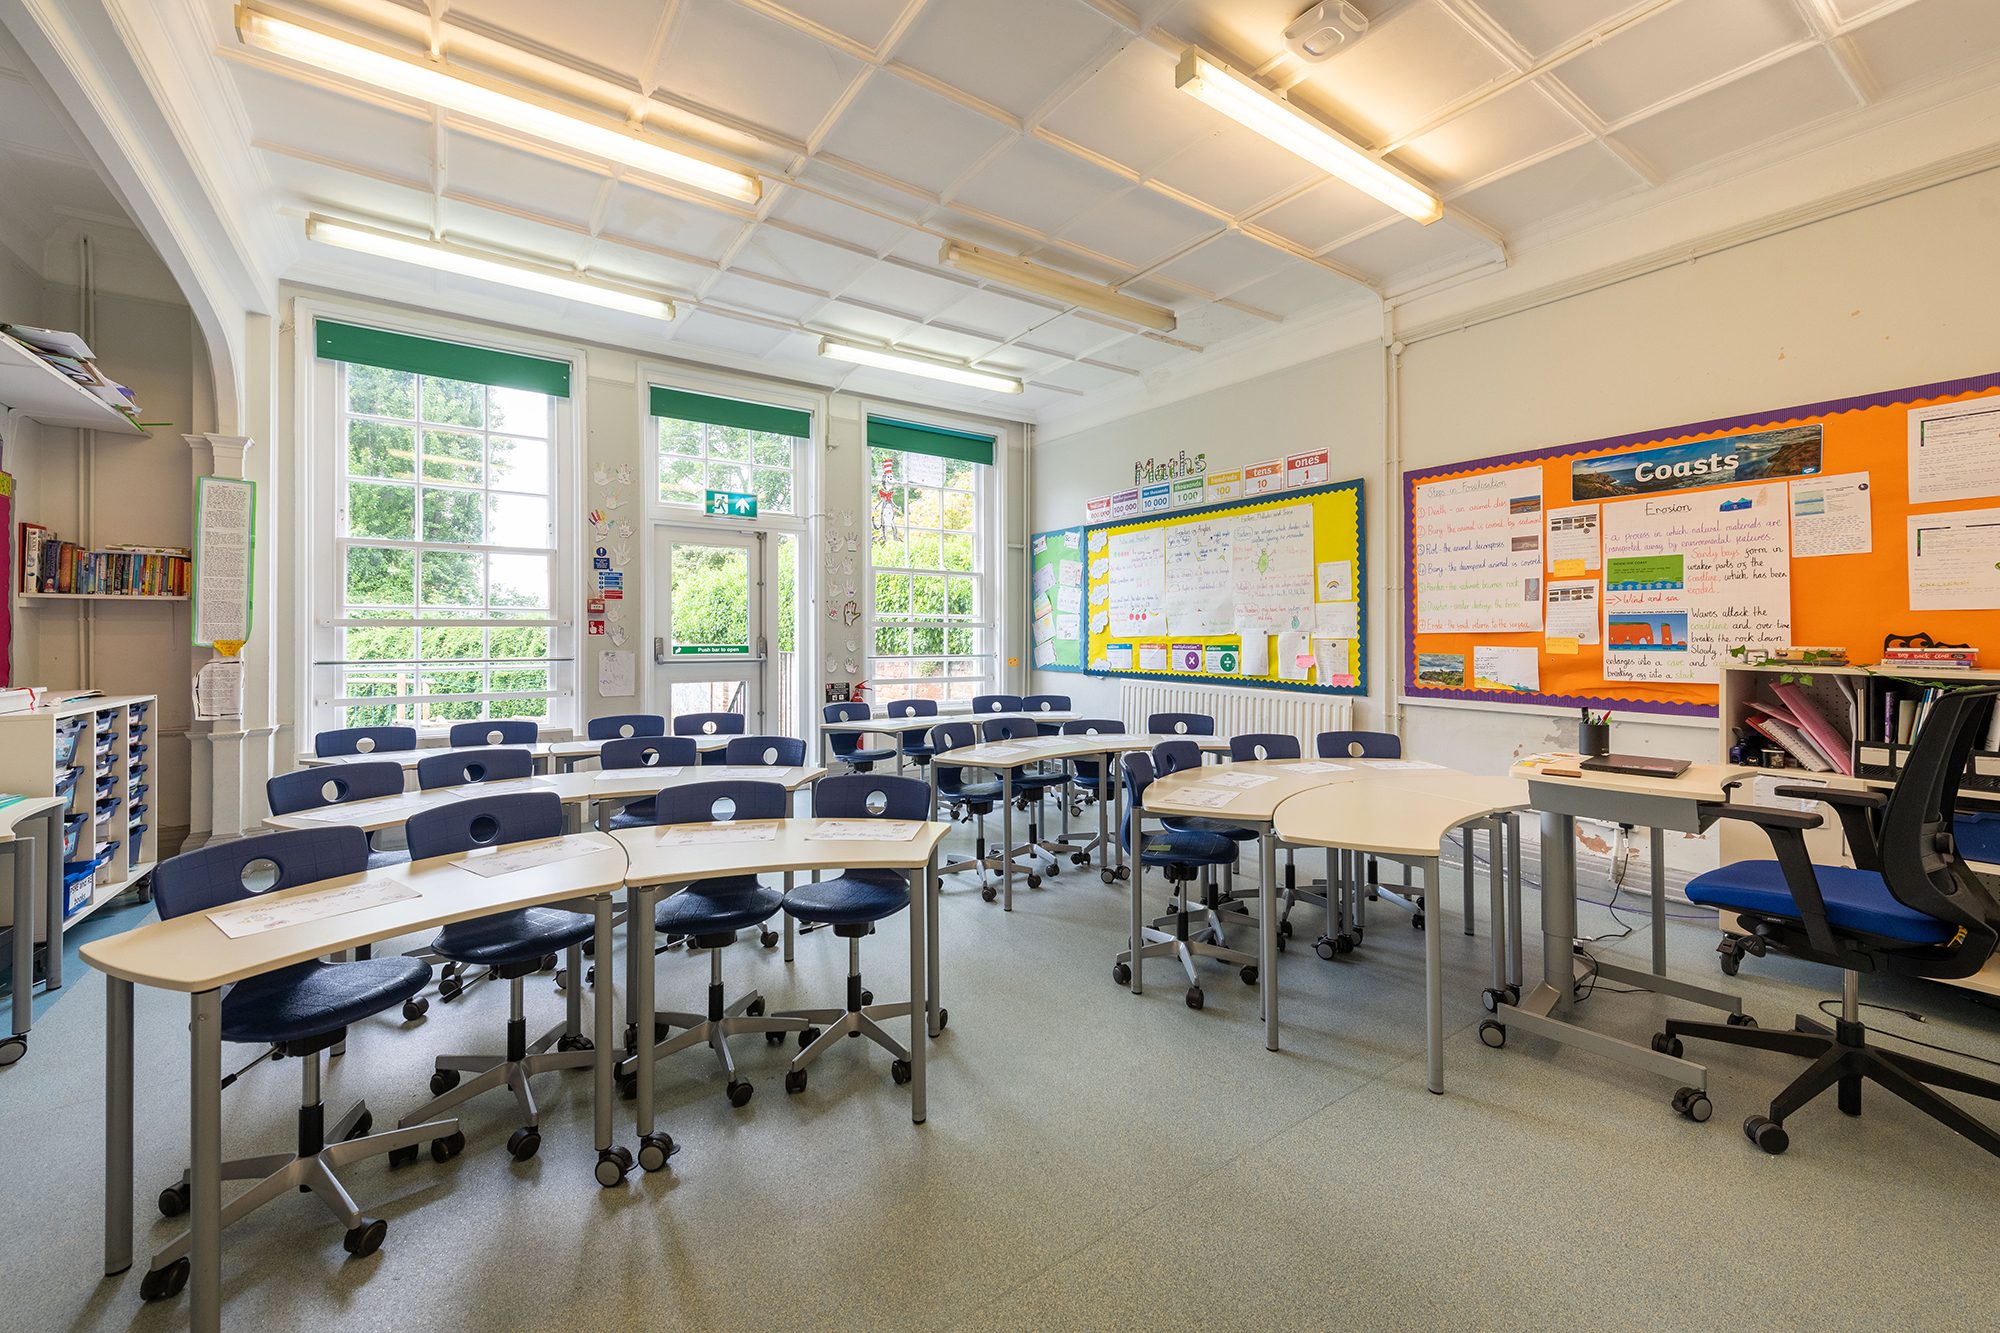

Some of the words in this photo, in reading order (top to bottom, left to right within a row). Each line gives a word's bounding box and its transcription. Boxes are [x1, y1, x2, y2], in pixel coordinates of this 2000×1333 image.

[1135, 450, 1207, 486] Maths
[1295, 456, 1320, 468] ones
[1634, 453, 1740, 482] Coasts
[1254, 467, 1272, 476] tens
[1304, 470, 1309, 480] 1
[1216, 486, 1230, 495] 100
[1258, 479, 1268, 488] 10
[1646, 502, 1692, 516] Erosion
[1625, 532, 1650, 543] process
[1666, 525, 1687, 536] which
[1692, 520, 1720, 534] natural
[1726, 518, 1761, 531] materials
[1644, 544, 1664, 554] away
[1668, 540, 1678, 552] by
[1692, 547, 1718, 562] Sandy
[1720, 546, 1740, 558] bays
[1744, 547, 1768, 558] form
[1688, 560, 1712, 570] weaker
[1716, 559, 1734, 572] parts
[1737, 562, 1748, 570] of
[1751, 557, 1764, 567] the
[1724, 570, 1748, 582] which
[1752, 569, 1767, 579] has
[1770, 568, 1788, 578] been
[1623, 592, 1644, 604] Wind
[1648, 591, 1662, 602] and
[1691, 607, 1718, 618] Waves
[1722, 606, 1749, 618] attack
[1753, 606, 1768, 616] the
[1732, 619, 1752, 630] and
[1691, 632, 1714, 642] breaks
[1718, 633, 1731, 642] the
[1734, 632, 1754, 642] rock
[1606, 654, 1636, 669] enlarges
[1638, 654, 1652, 666] into
[1689, 656, 1708, 668] and
[1606, 666, 1634, 680] breaking
[1649, 668, 1662, 679] into
